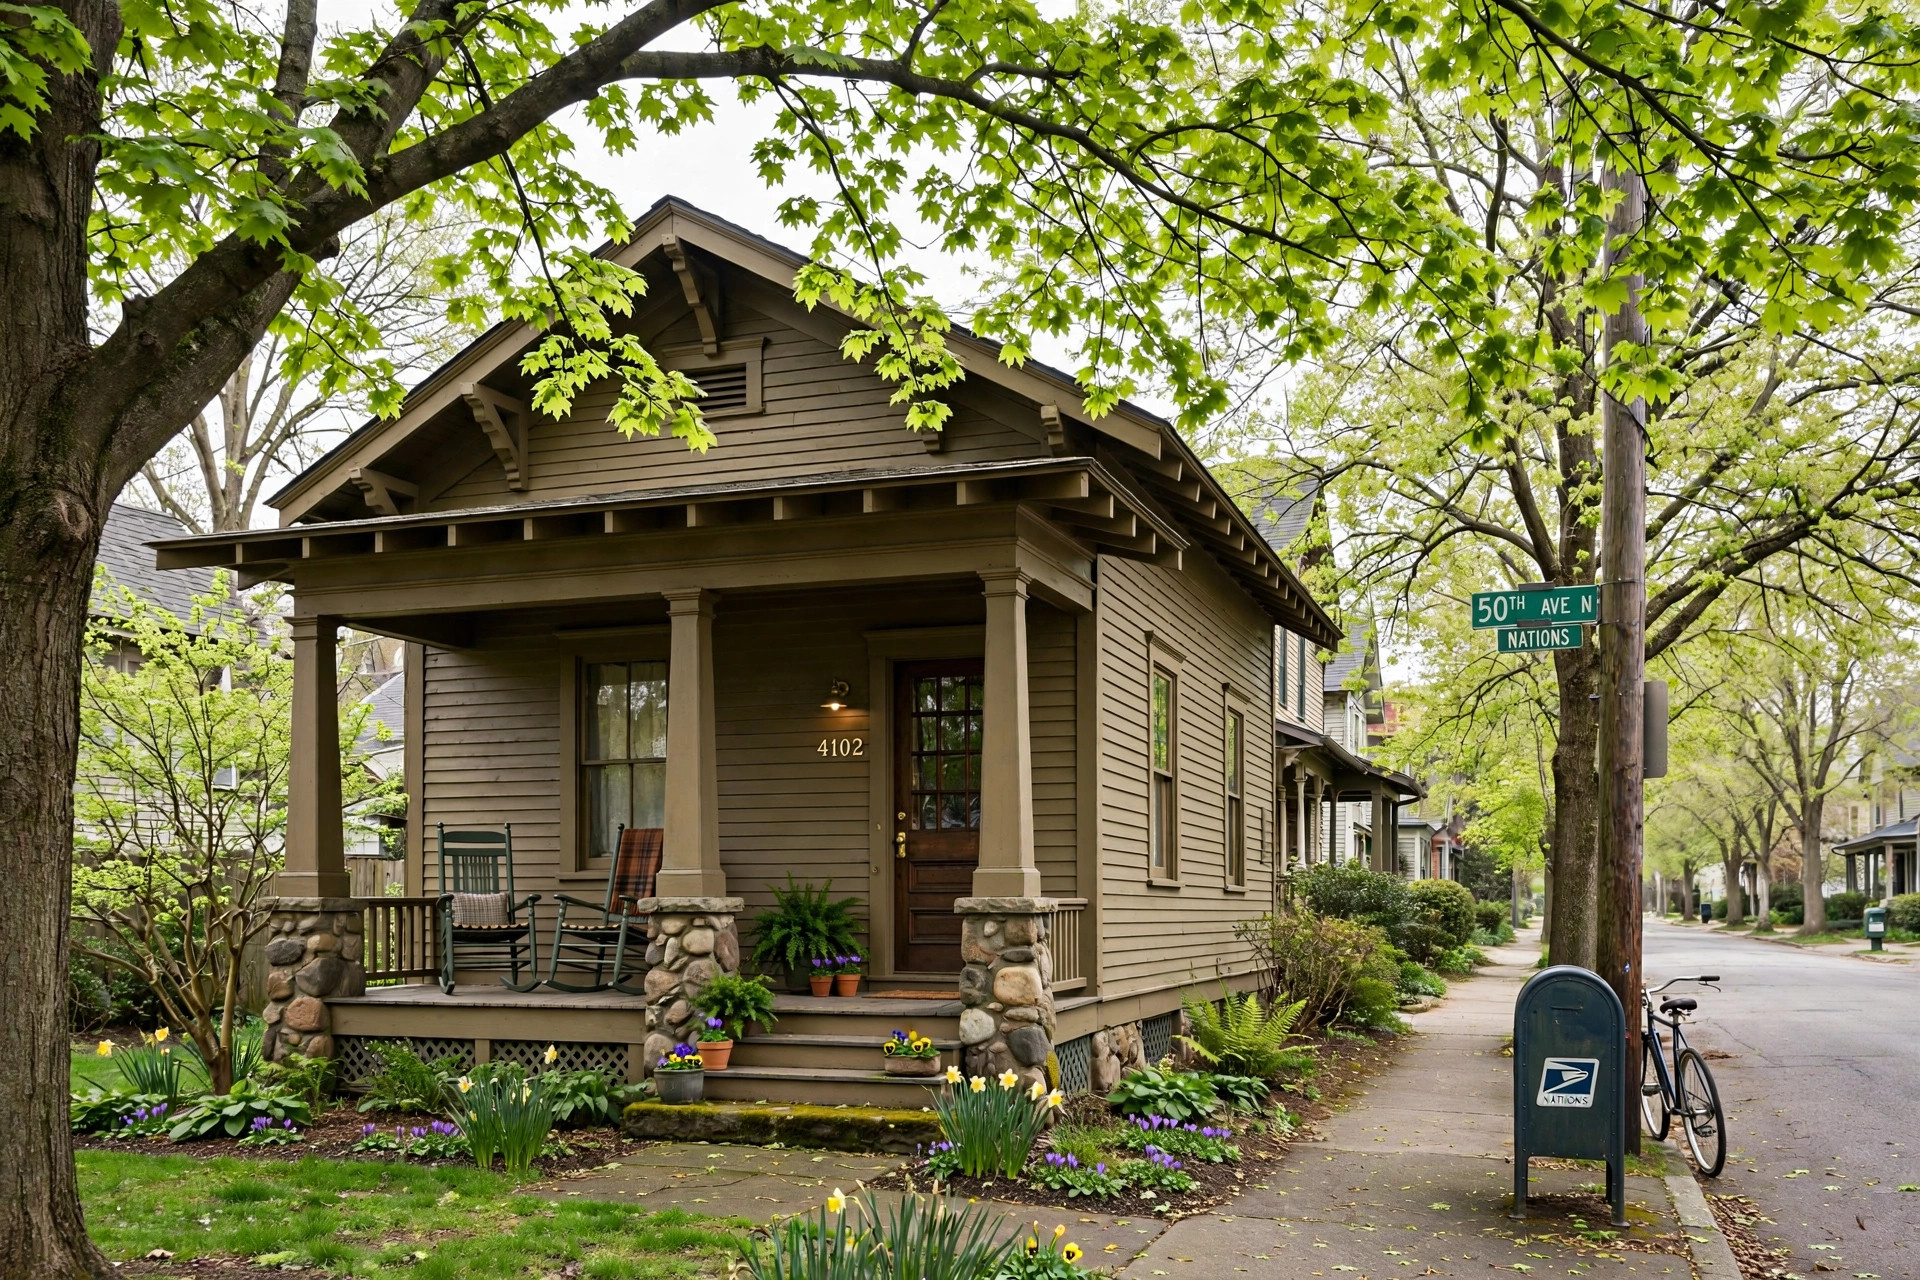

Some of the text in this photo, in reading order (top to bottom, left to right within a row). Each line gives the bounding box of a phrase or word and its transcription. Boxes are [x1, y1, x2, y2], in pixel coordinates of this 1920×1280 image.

[1478, 595, 1592, 623] 50TH AVE N
[1508, 629, 1570, 649] NATIONS
[816, 738, 864, 757] 4102
